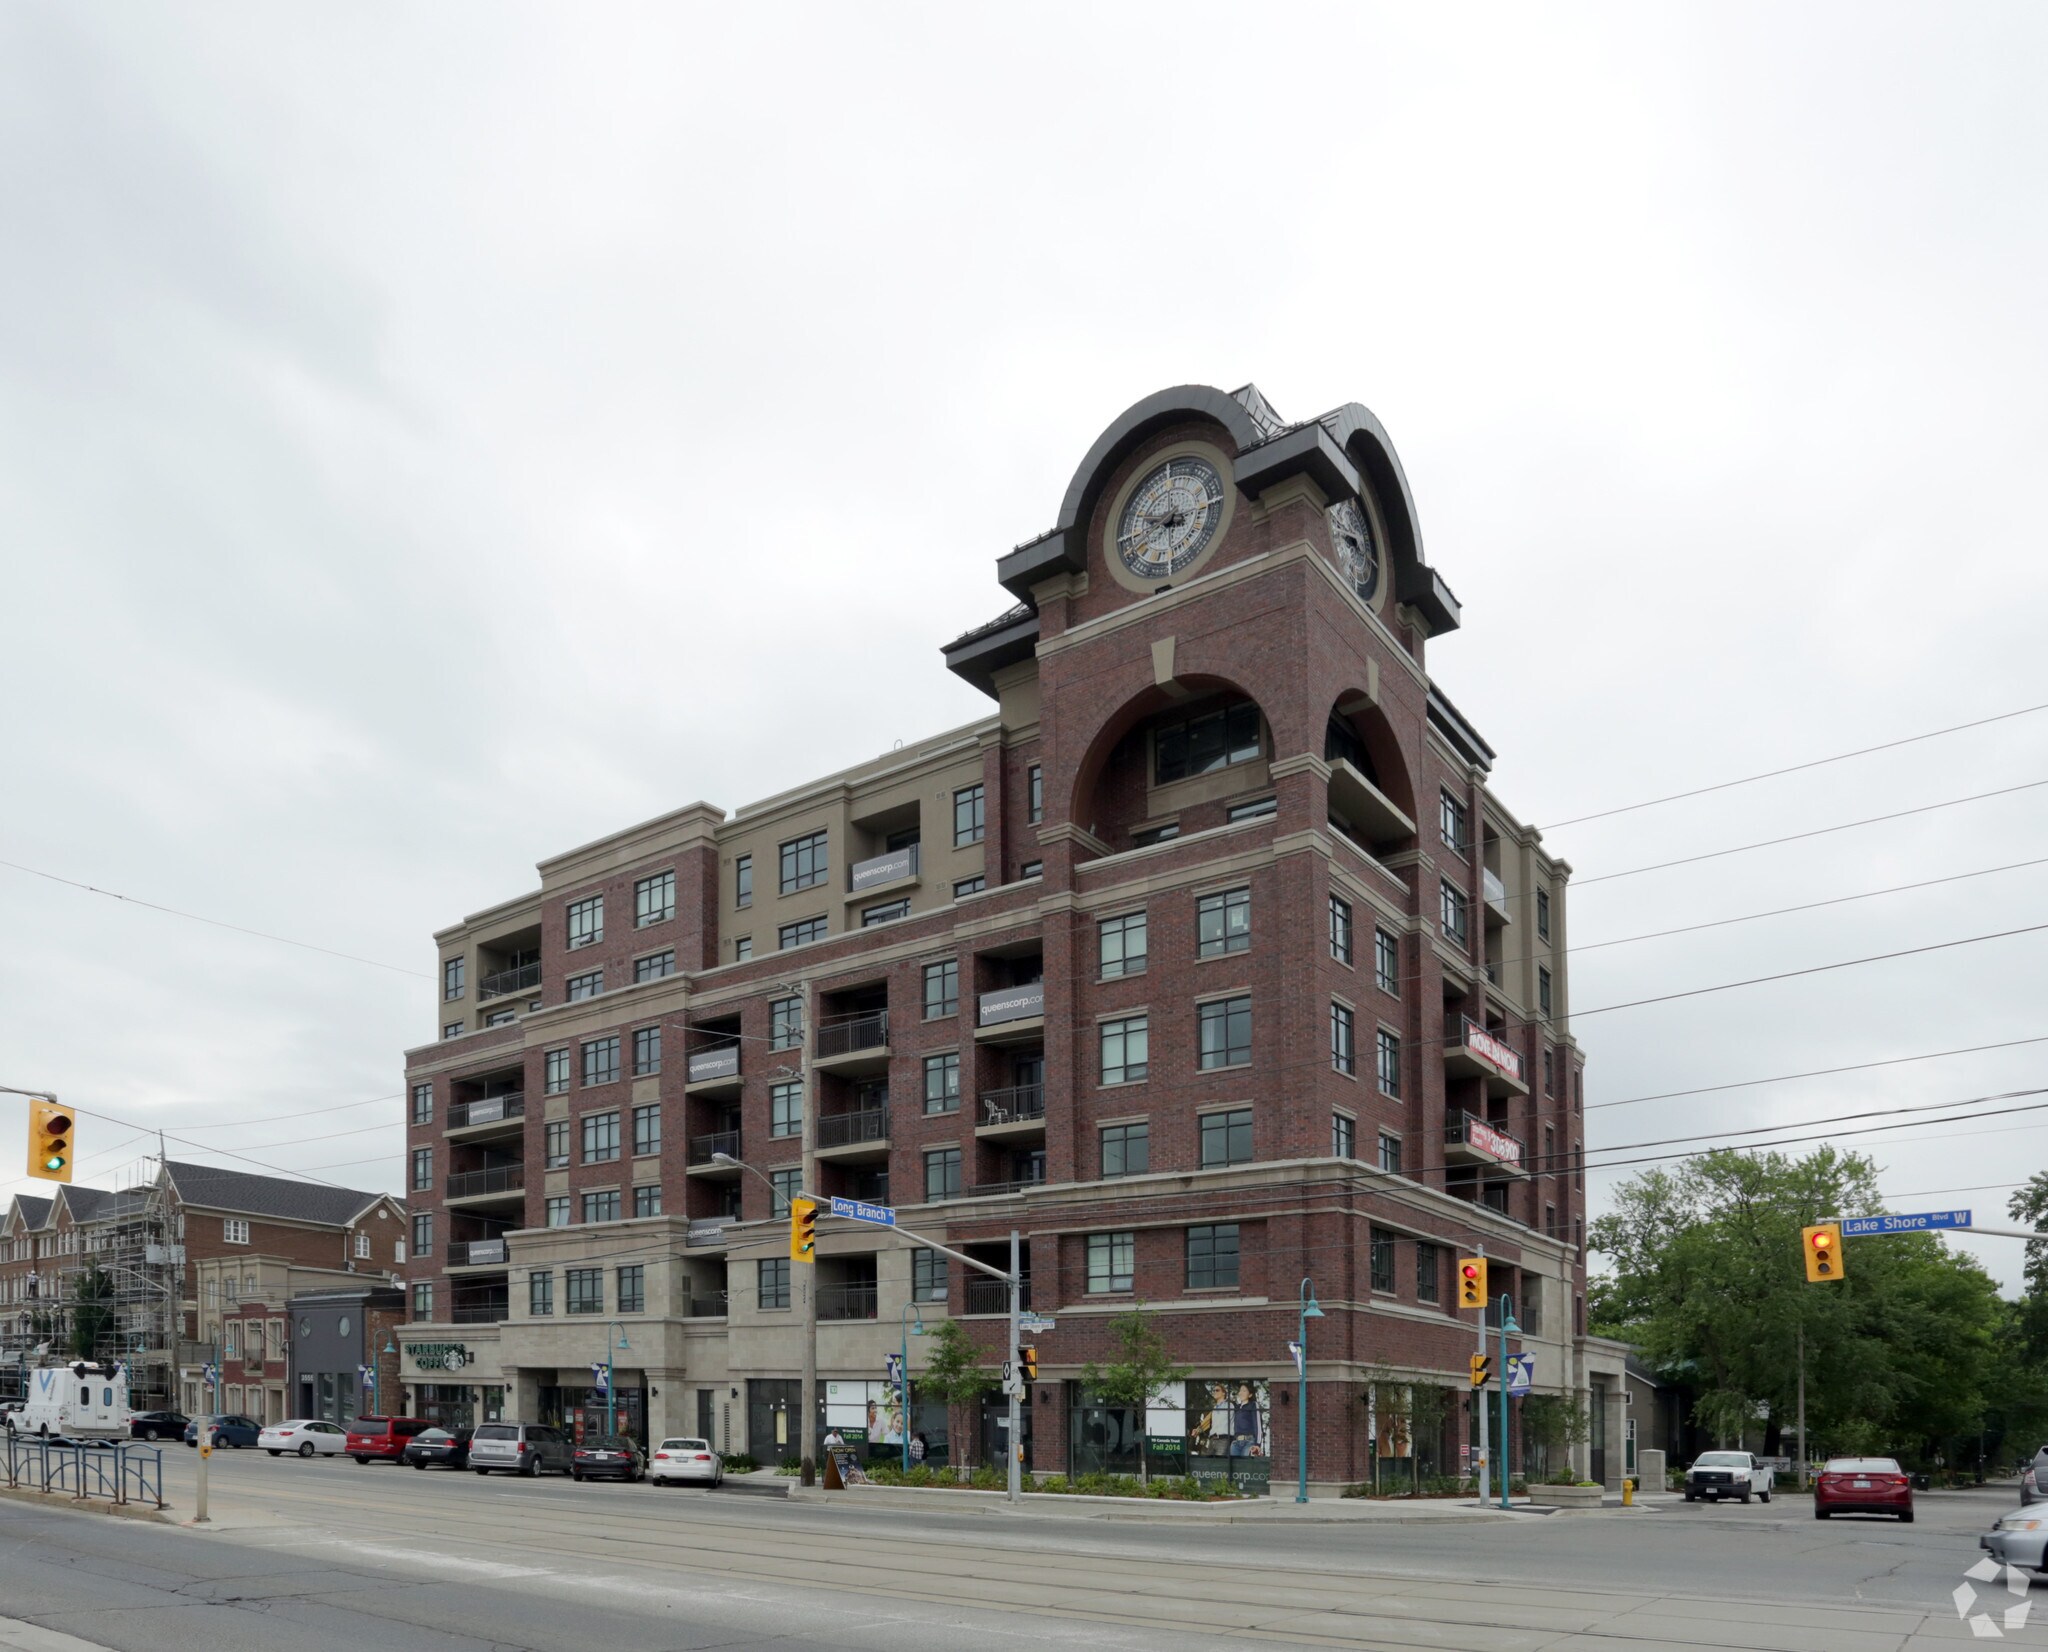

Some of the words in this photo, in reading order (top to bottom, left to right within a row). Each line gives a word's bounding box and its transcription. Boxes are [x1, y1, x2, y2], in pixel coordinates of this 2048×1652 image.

[853, 860, 908, 882] queenscorp.com
[690, 1058, 736, 1074] queenscorp.com
[833, 1199, 854, 1217] Long
[857, 1204, 886, 1220] Branch
[1846, 1220, 1878, 1232] Lake
[1884, 1217, 1927, 1230] Shore
[1932, 1213, 1949, 1221] Blvd
[1954, 1212, 1967, 1224] W
[1165, 1443, 1181, 1451] 2014
